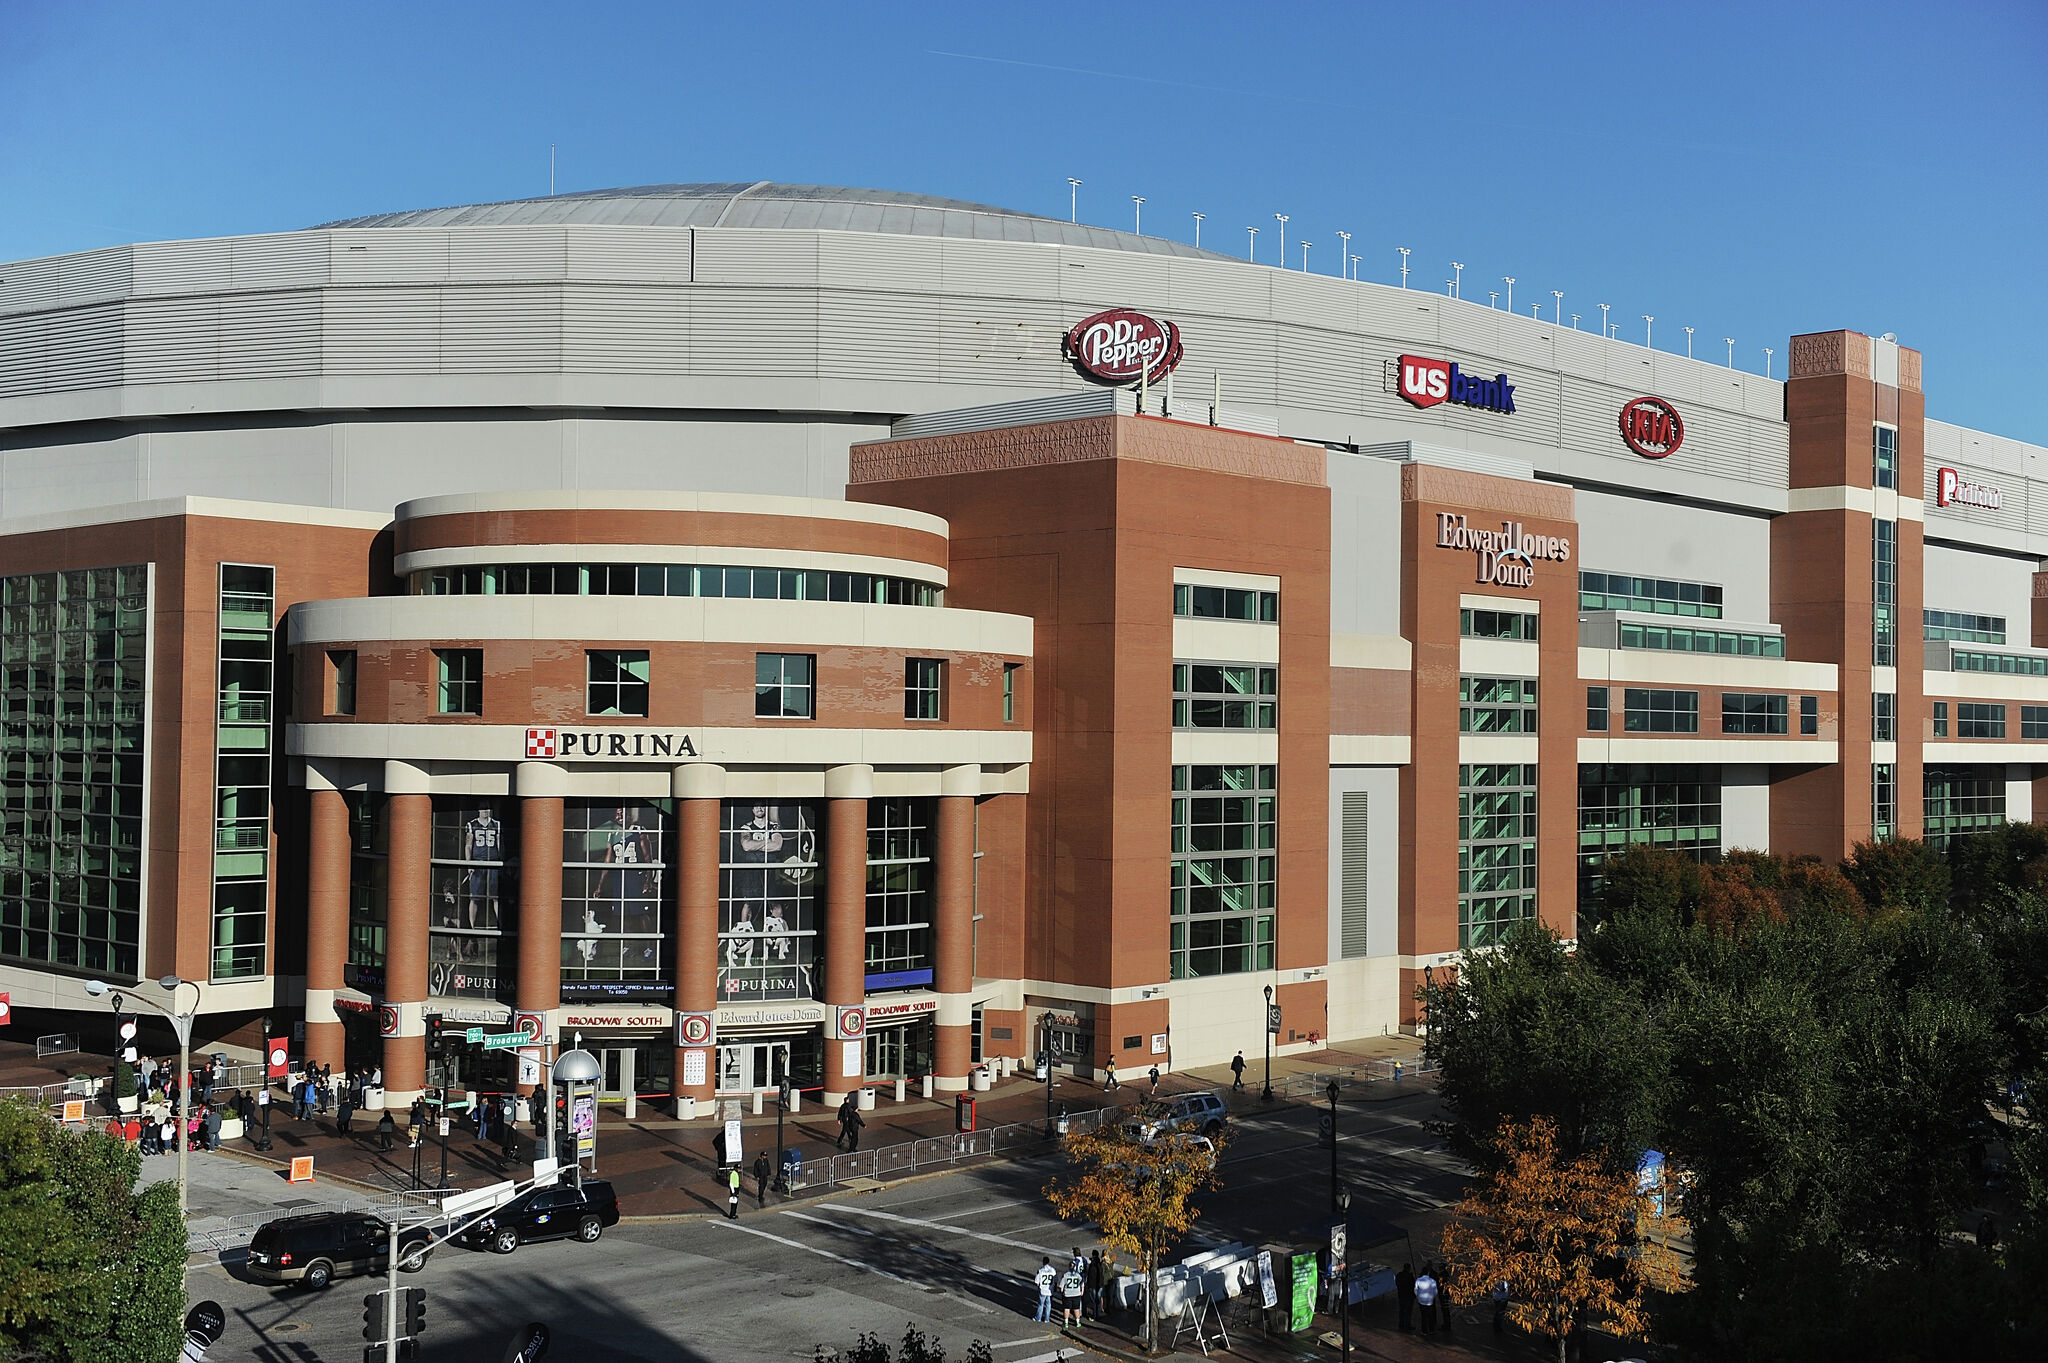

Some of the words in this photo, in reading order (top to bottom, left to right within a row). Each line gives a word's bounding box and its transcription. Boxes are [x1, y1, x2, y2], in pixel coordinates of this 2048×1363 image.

[1113, 319, 1144, 346] Dr
[1631, 408, 1673, 445] KIA
[1436, 512, 1513, 552] Edward
[1513, 523, 1570, 561] Jones
[1476, 549, 1535, 587] Dome
[560, 733, 698, 757] PURINA
[740, 978, 796, 991] PURINA
[869, 1003, 911, 1016] BROADWAY
[912, 1001, 936, 1012] SOUTH
[567, 1016, 623, 1026] BROADWAY
[627, 1016, 663, 1026] SOUTH
[720, 1011, 759, 1024] Edward
[759, 1010, 793, 1023] Jones
[848, 1015, 860, 1031] B
[690, 1021, 704, 1037] B
[486, 1036, 529, 1046] Broadway
[1041, 1274, 1054, 1286] 29
[1066, 1277, 1079, 1289] 29
